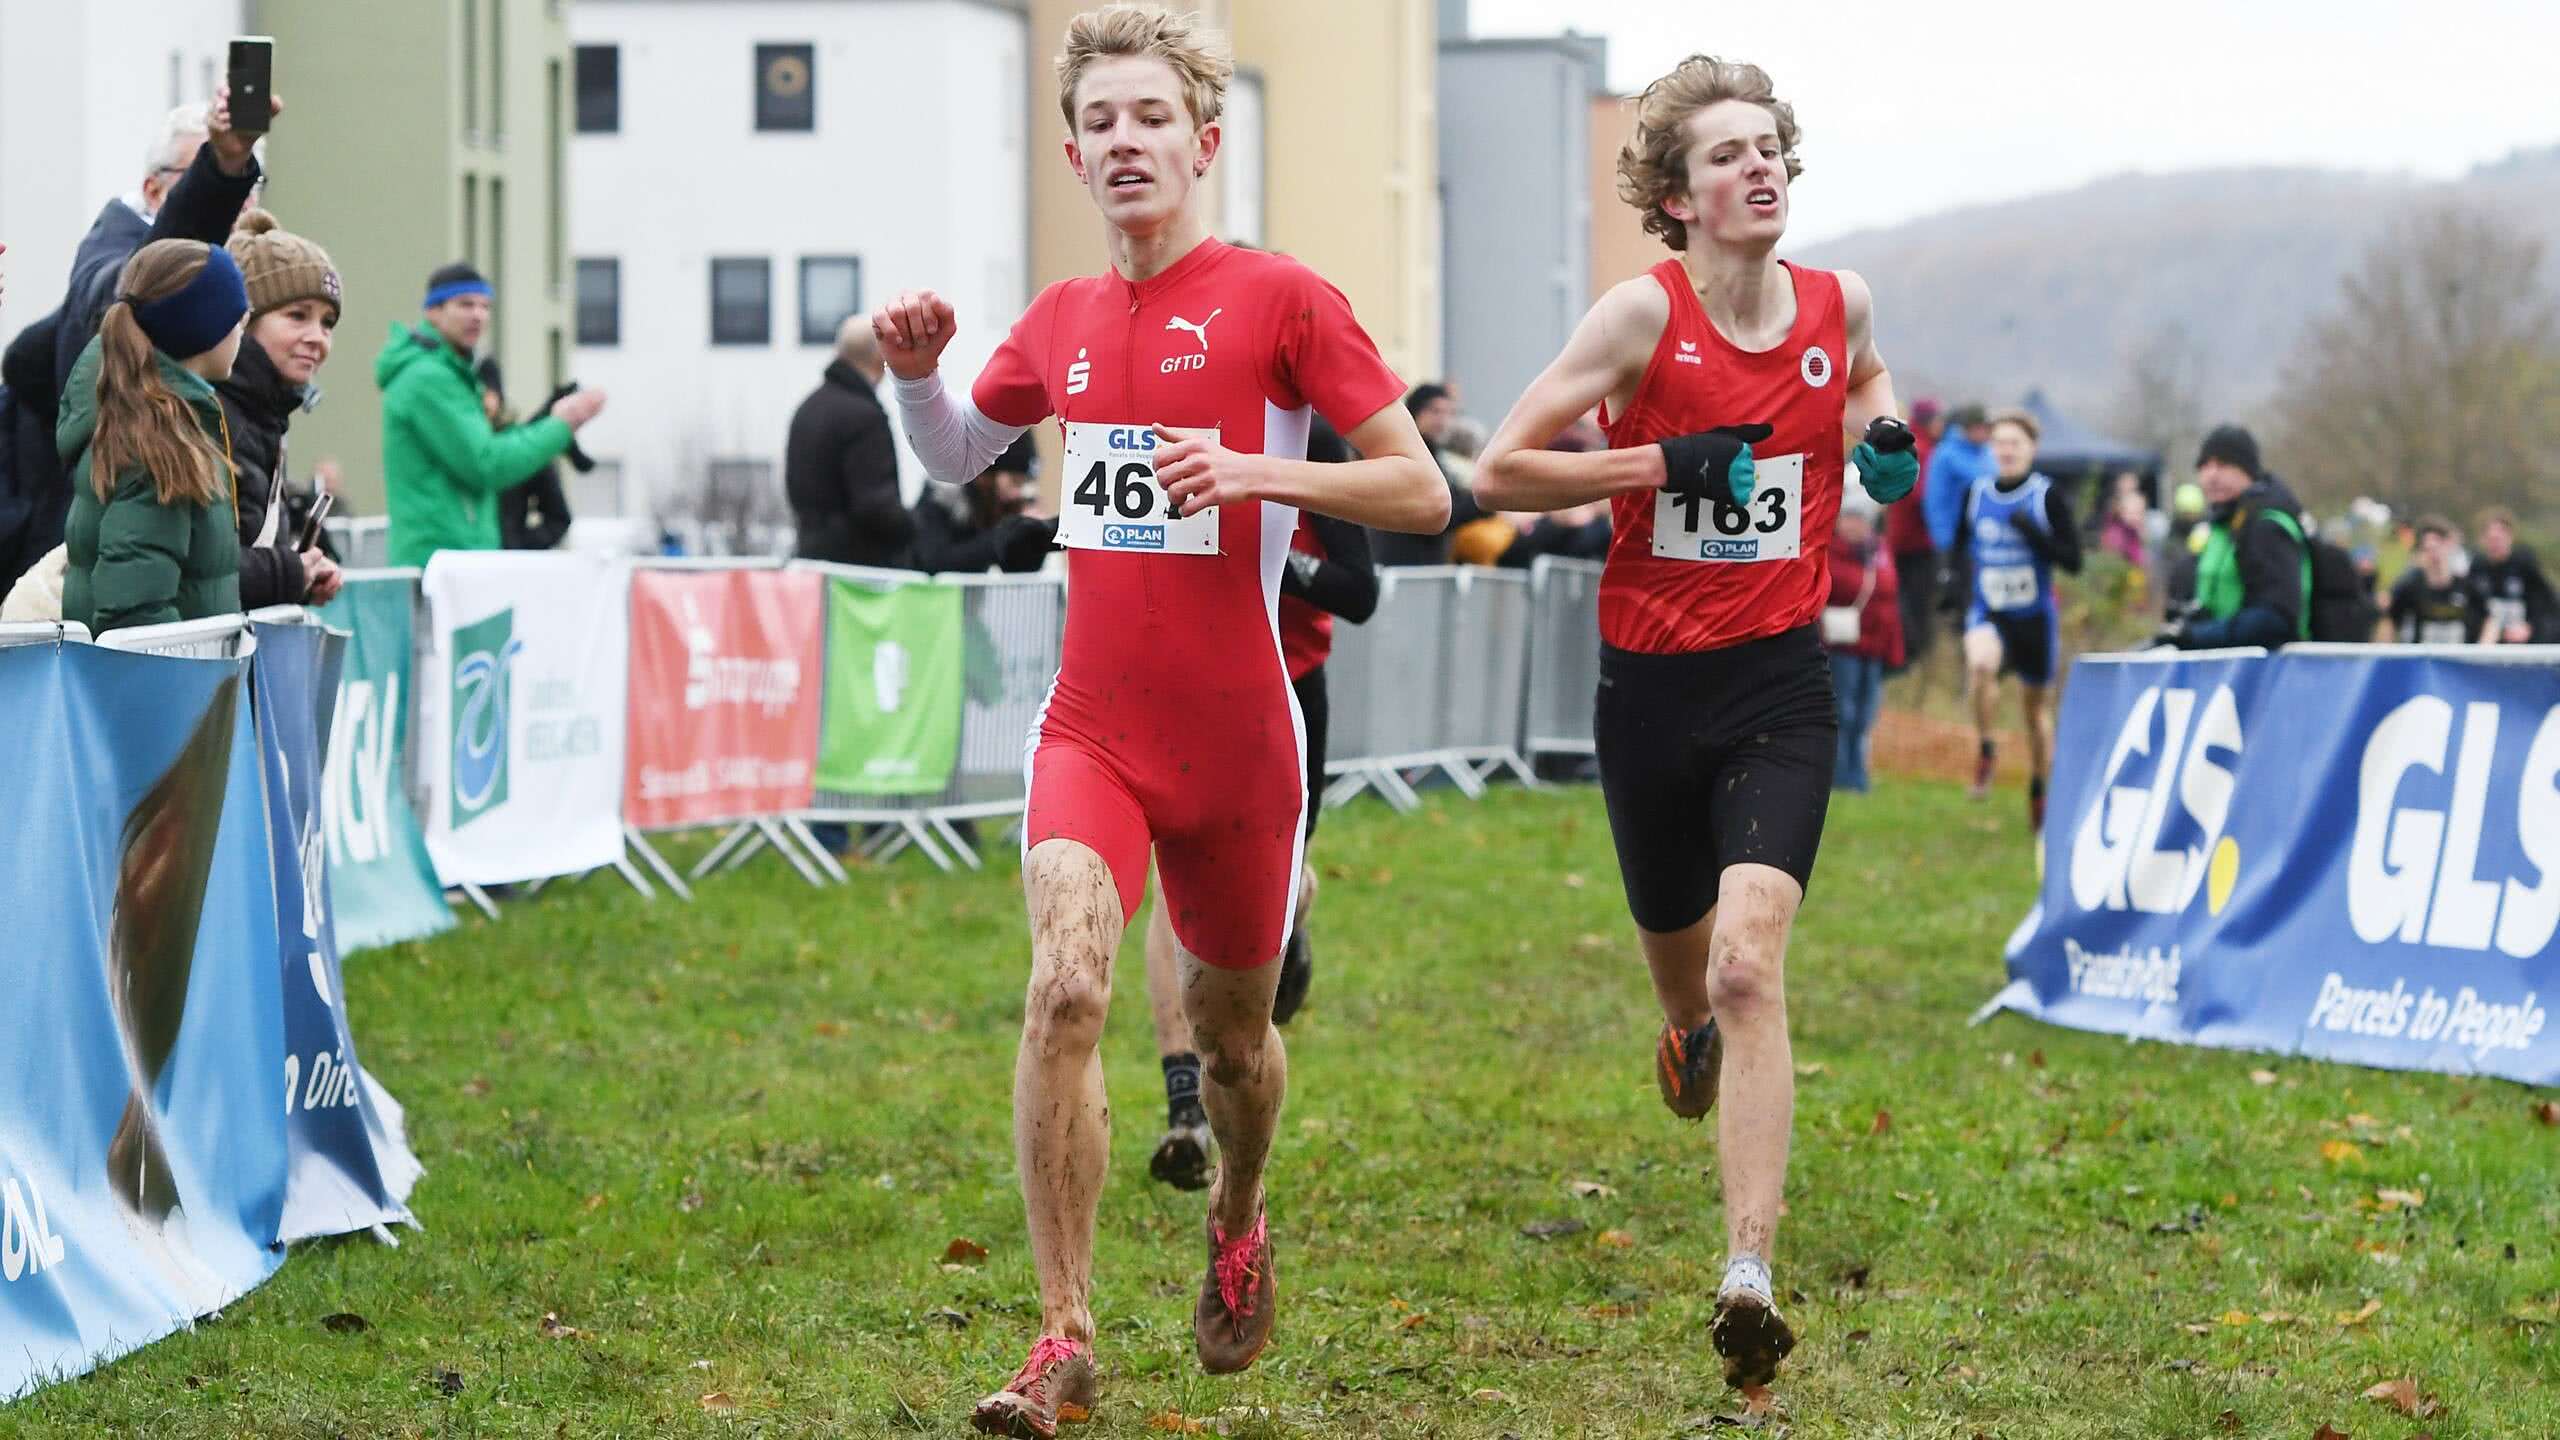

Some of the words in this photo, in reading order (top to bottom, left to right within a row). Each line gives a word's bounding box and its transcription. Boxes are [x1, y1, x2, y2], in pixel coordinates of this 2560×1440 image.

[1160, 354, 1206, 373] GfTD
[1126, 528, 1162, 541] PLAN
[1724, 543, 1757, 553] PLAN
[2308, 971, 2415, 1038] Parcels
[2407, 985, 2449, 1042] to
[2439, 985, 2547, 1063] People
